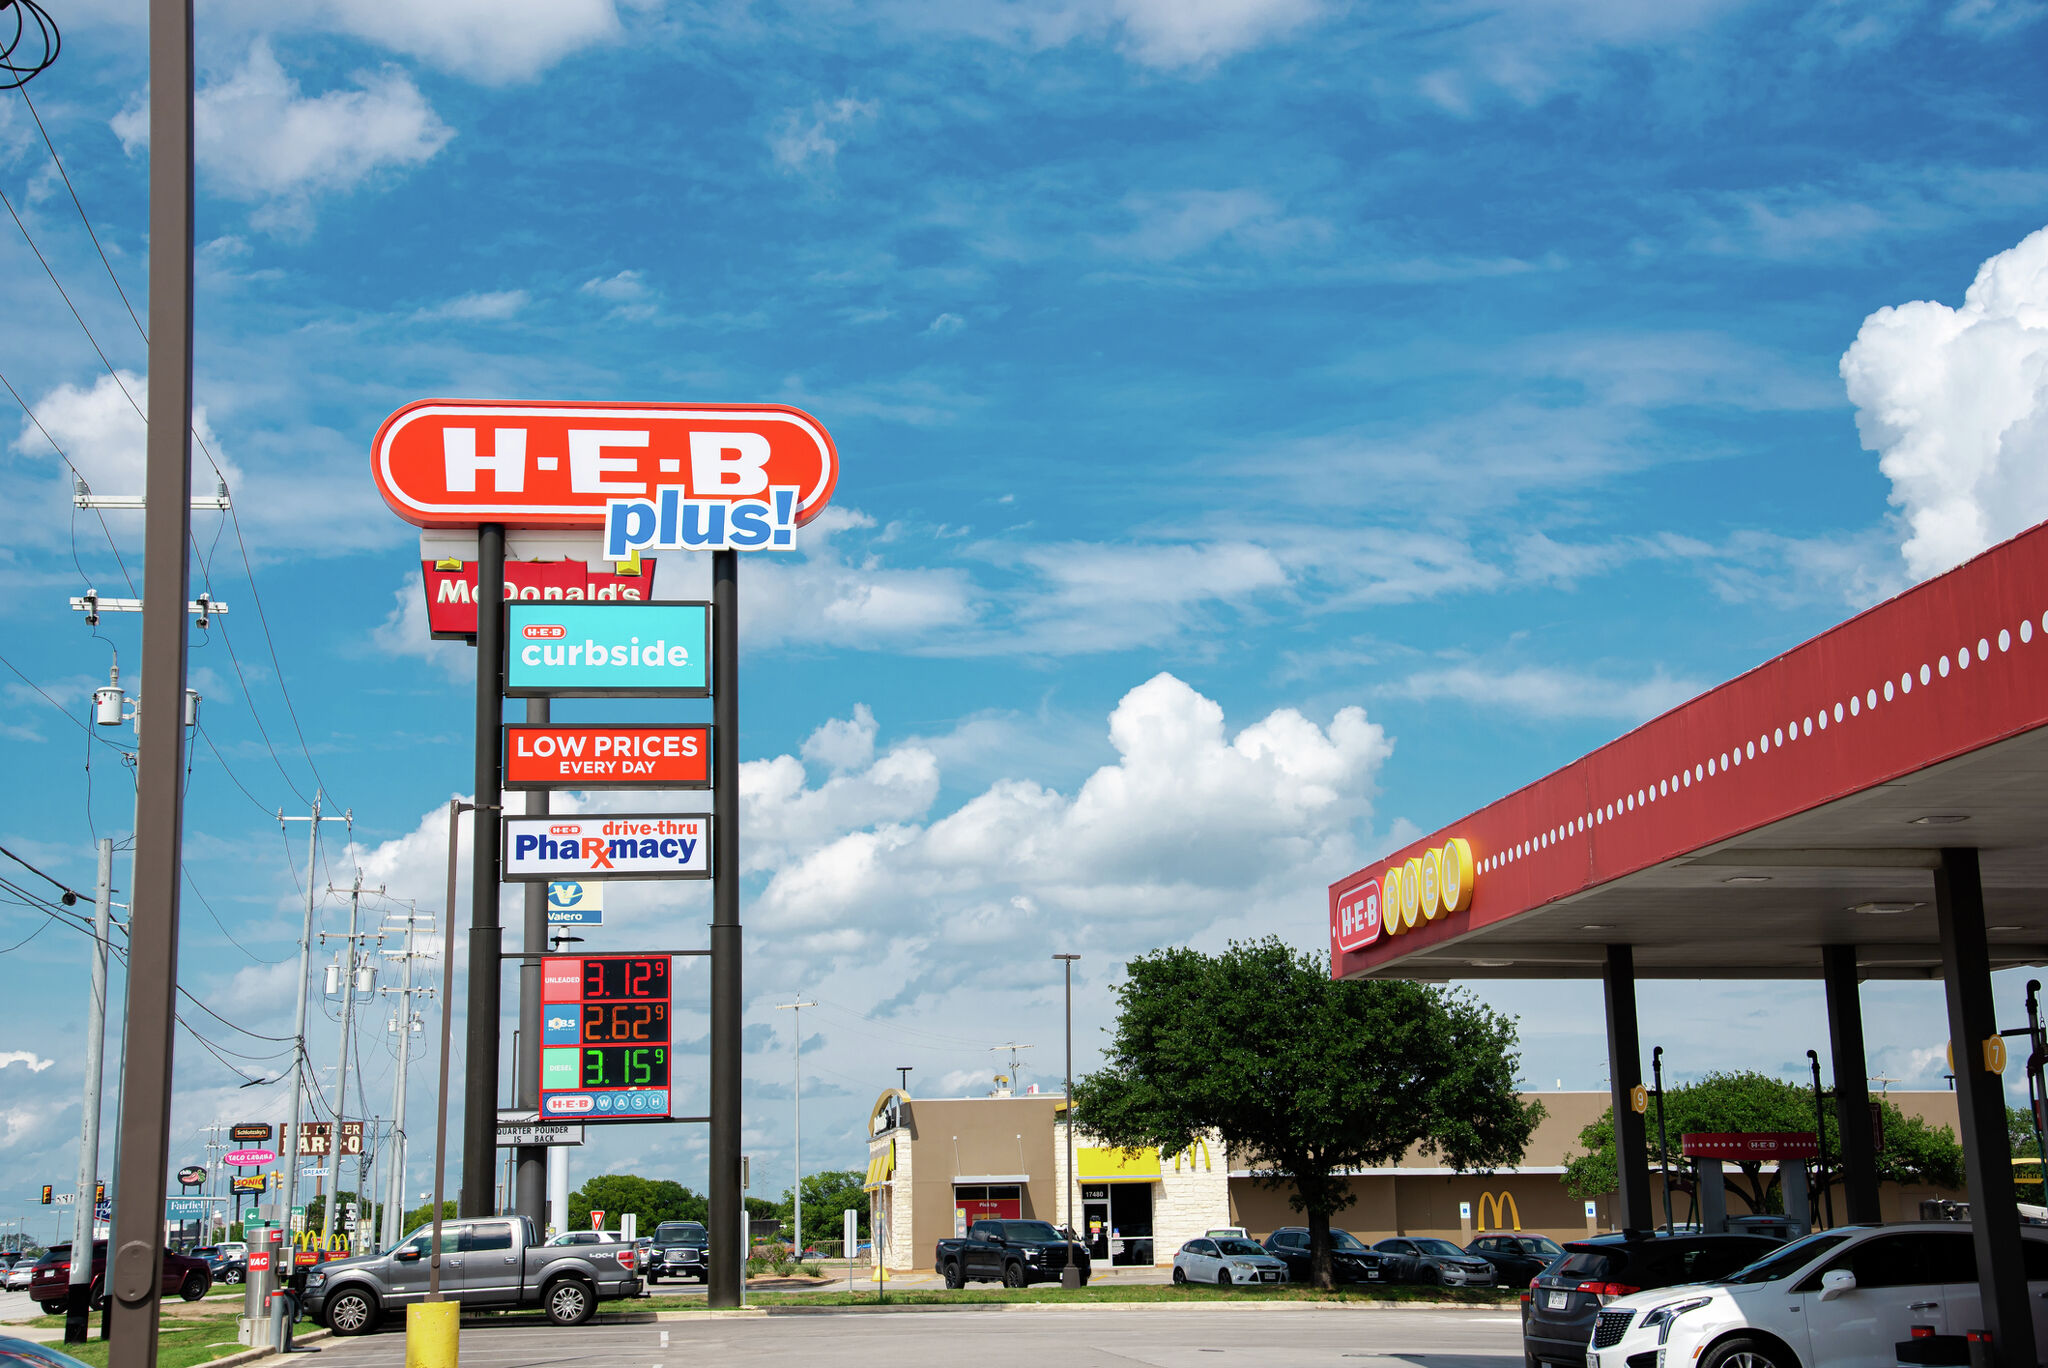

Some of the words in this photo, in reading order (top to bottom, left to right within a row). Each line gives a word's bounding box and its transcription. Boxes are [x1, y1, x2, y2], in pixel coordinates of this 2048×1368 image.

[442, 427, 771, 495] H-E-B
[607, 488, 796, 557] plus!
[527, 628, 562, 636] H-E-B
[521, 637, 689, 666] curbside
[517, 737, 587, 757] LOW
[595, 736, 698, 757] PRICES
[560, 762, 617, 774] EVERY
[622, 761, 656, 773] DAY
[602, 821, 697, 836] drive-thru
[1385, 854, 1458, 922] FUEL
[548, 912, 583, 921] Valero
[1341, 894, 1377, 937] H-E-B
[544, 976, 580, 984] UNLEADED
[1992, 1046, 2000, 1065] 7
[549, 1064, 573, 1072] DIESEL
[553, 1100, 589, 1109] H-E-B
[1637, 1092, 1644, 1106] 9
[497, 1127, 532, 1135] QUARTER
[534, 1126, 569, 1134] POUNDER
[513, 1135, 522, 1144] IS
[534, 1135, 555, 1143] BACK
[236, 1177, 263, 1187] SONIC
[250, 1257, 268, 1266] VAC
